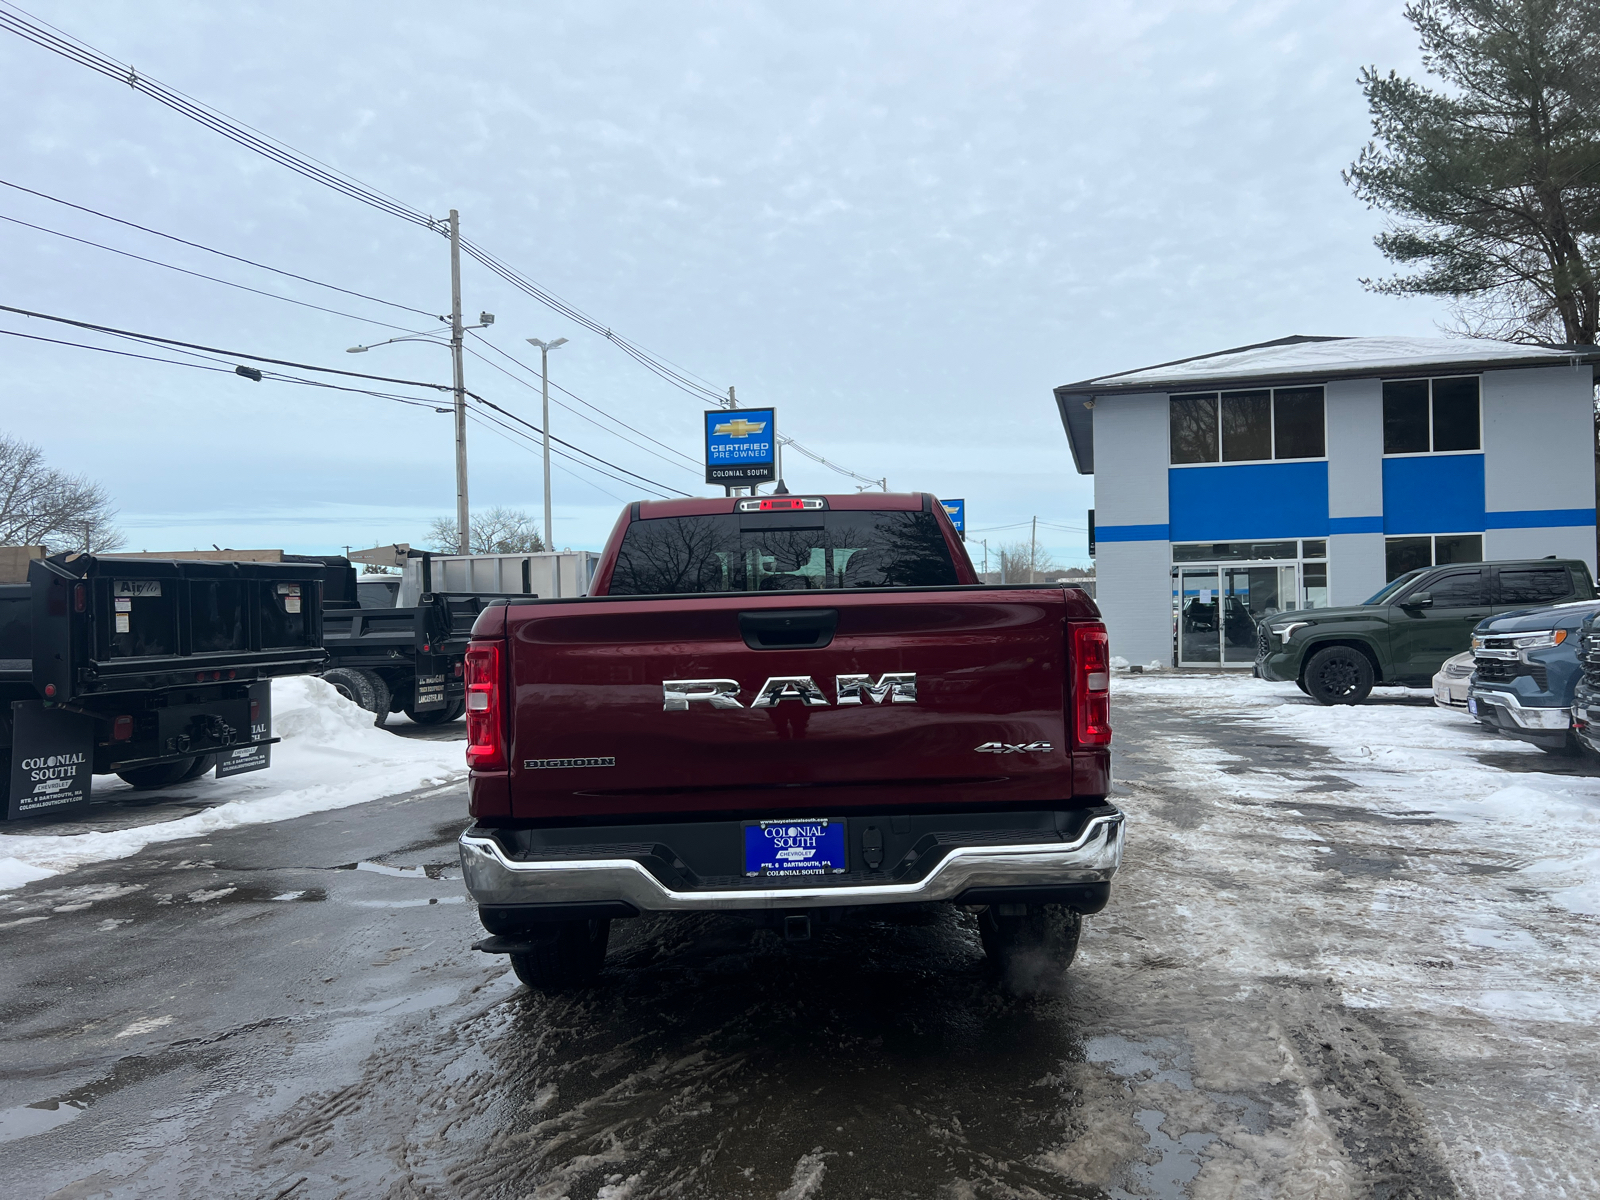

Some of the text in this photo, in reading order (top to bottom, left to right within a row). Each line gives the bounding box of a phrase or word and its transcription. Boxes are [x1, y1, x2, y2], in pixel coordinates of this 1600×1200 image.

[711, 443, 769, 452] CERTIFIED
[713, 450, 766, 458] PRE-OWNED
[662, 672, 918, 711] RAM
[21, 752, 86, 770] COLONIAL
[523, 757, 615, 769] BIGHORN
[30, 766, 77, 781] SOUTH
[37, 781, 69, 791] CHEVROLET
[39, 791, 73, 801] DARTMOUTH,
[19, 796, 83, 811] COLONIALSOUTHCHEVY.COM
[764, 826, 826, 838] COLONIAL
[774, 837, 817, 848] SOUTH
